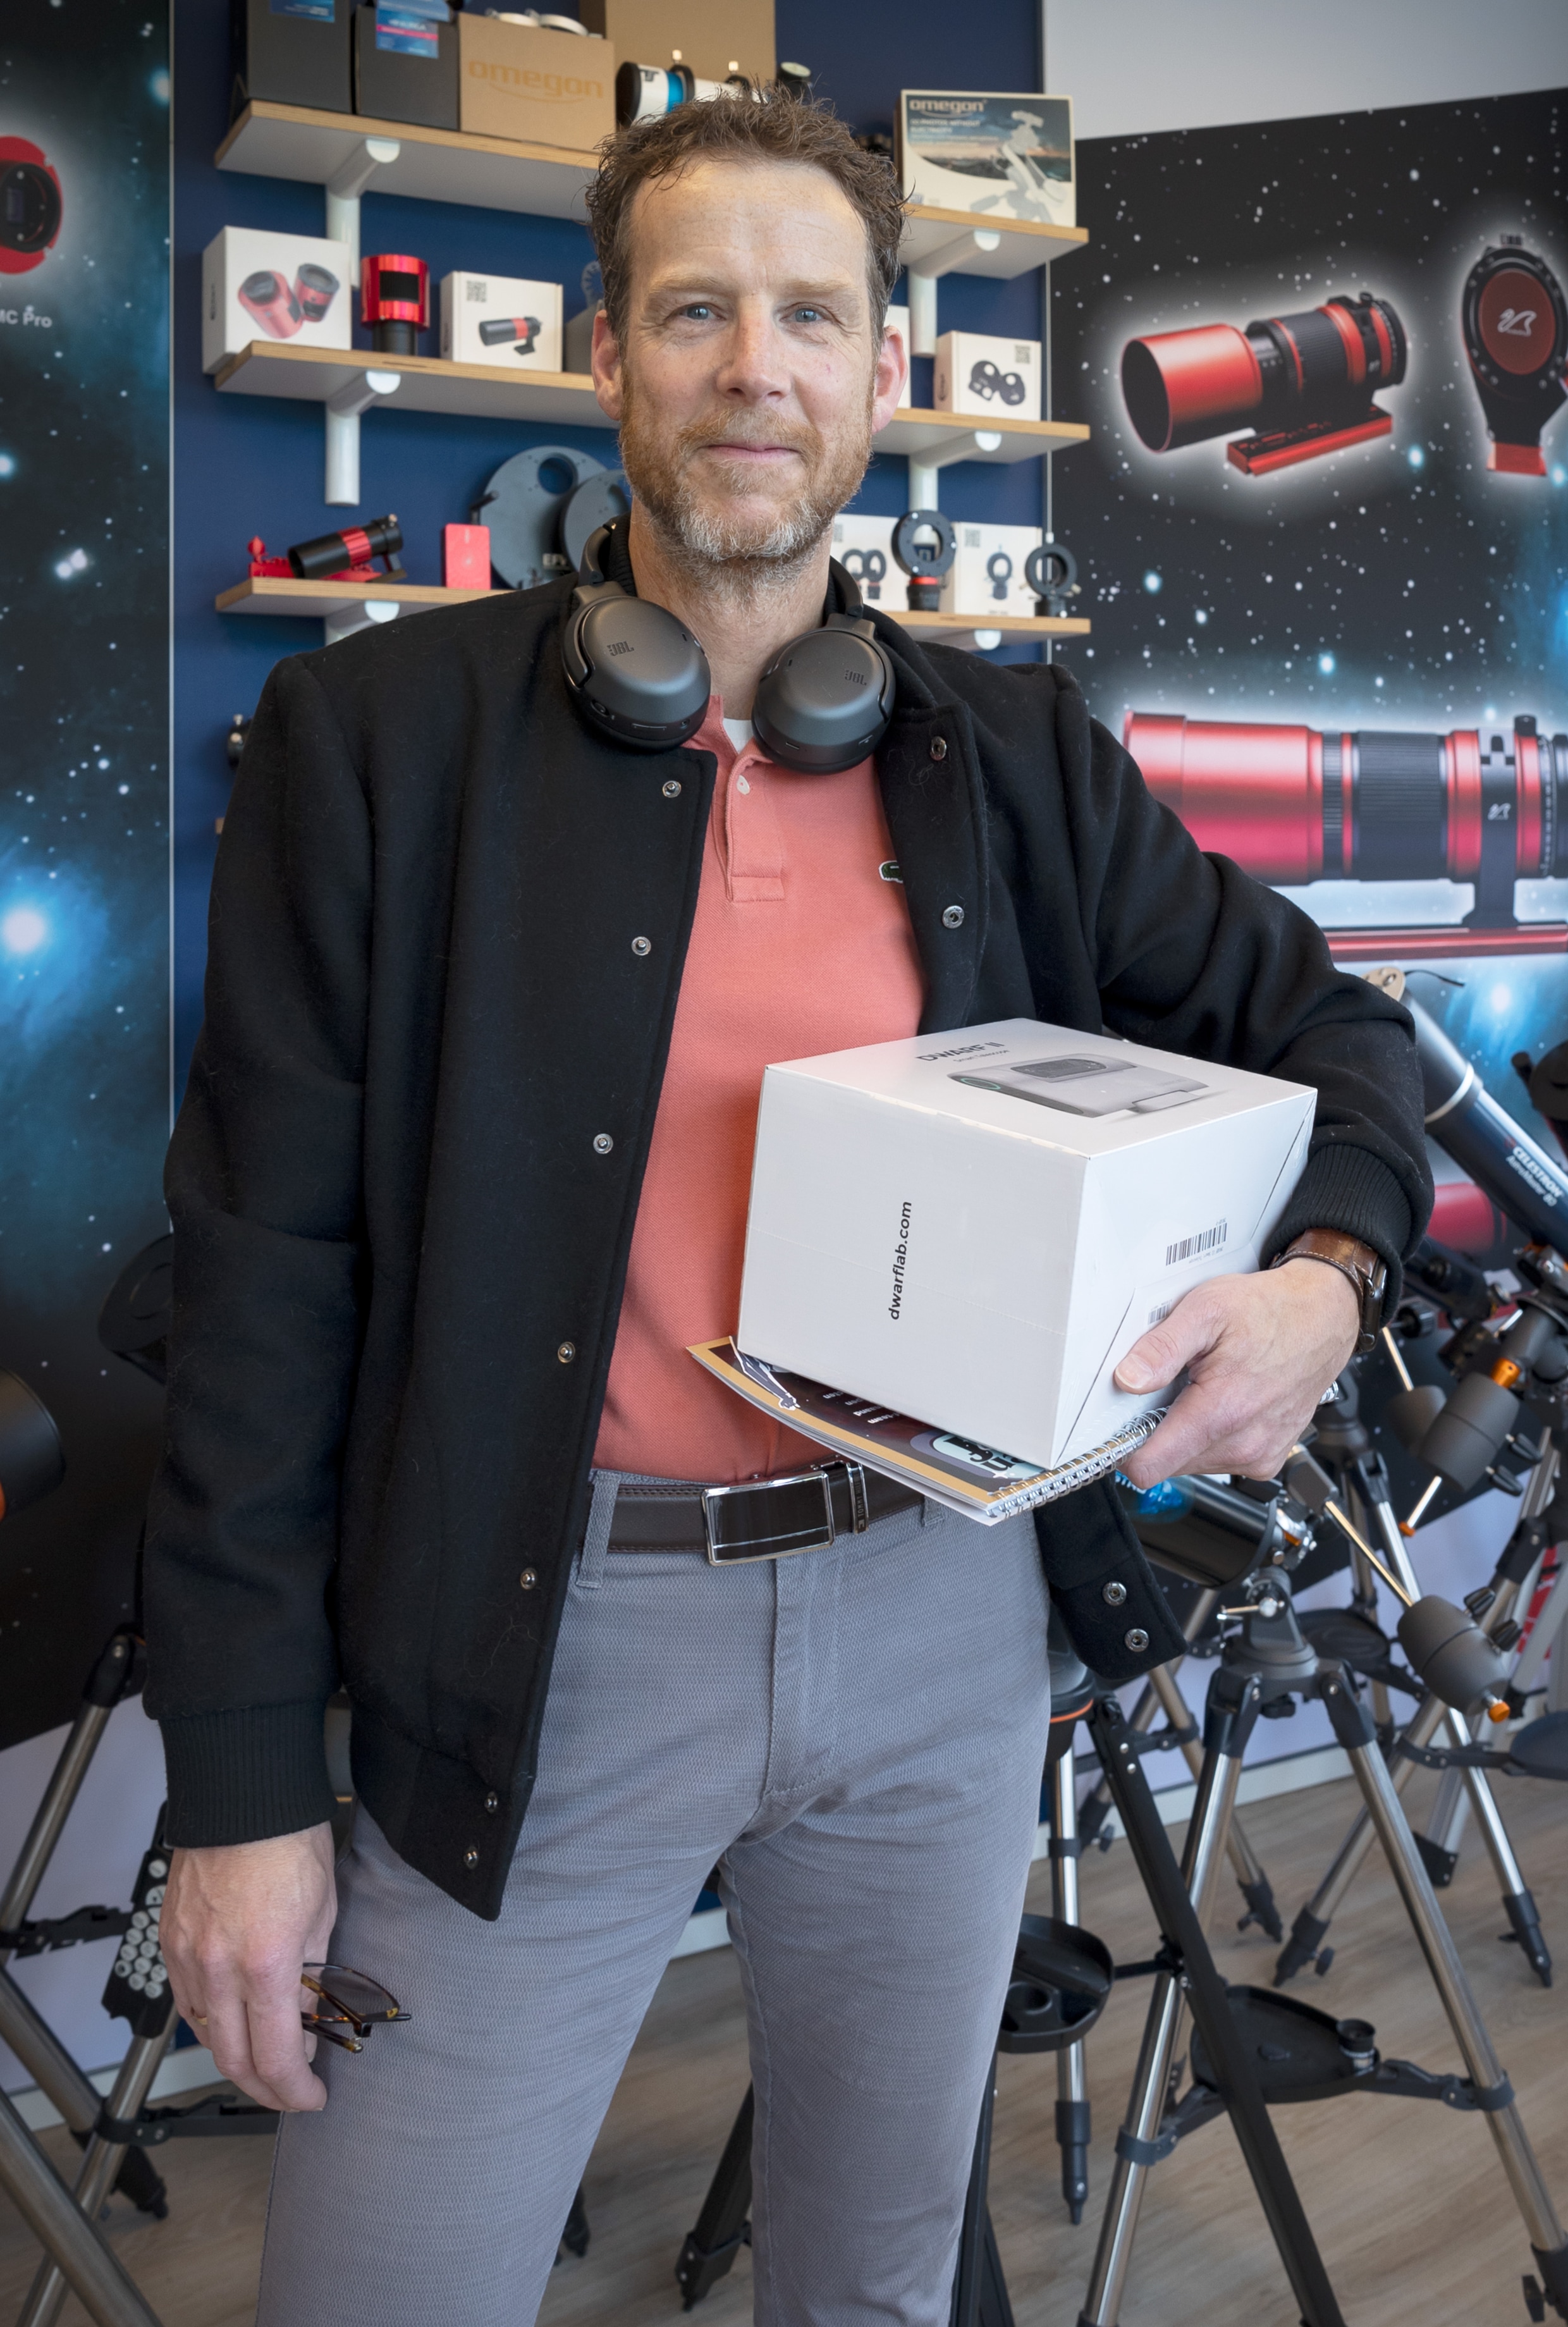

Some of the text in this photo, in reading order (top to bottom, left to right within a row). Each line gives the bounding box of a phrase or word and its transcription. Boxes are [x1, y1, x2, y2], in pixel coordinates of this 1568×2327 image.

[469, 61, 603, 99] omegon
[909, 99, 984, 114] omegon
[23, 311, 52, 328] Pro
[607, 641, 634, 656] JBL
[845, 670, 866, 685] JBL
[915, 1044, 986, 1061] DWARF
[1512, 1146, 1564, 1197] CELESTRON
[888, 1201, 912, 1320] dwarflab.com
